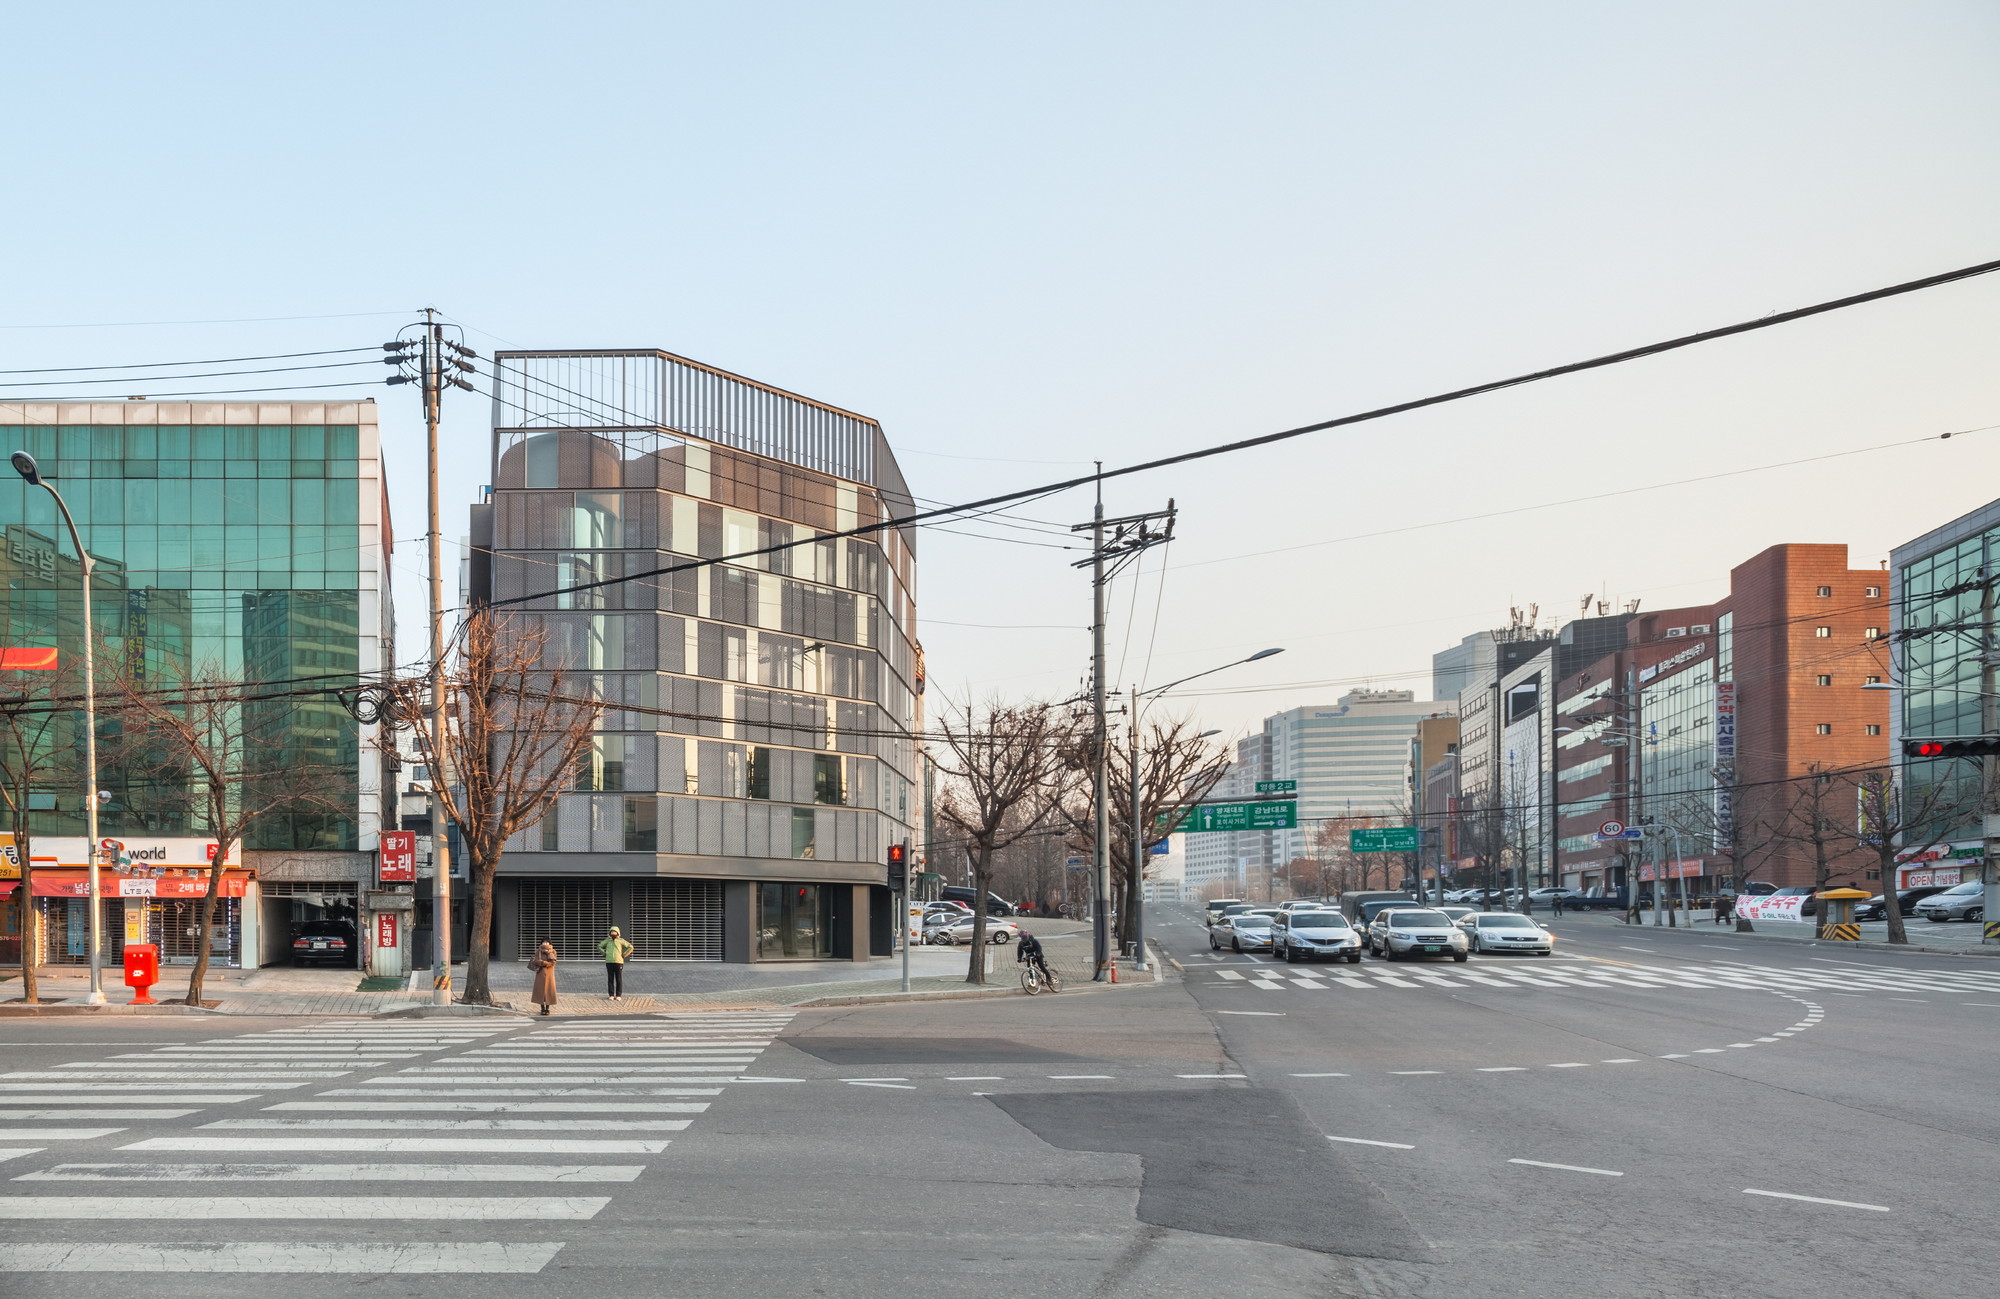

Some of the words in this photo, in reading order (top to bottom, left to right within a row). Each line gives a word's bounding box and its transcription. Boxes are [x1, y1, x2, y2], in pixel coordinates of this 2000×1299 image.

[1717, 683, 1735, 714] 현수막
[1259, 782, 1292, 790] 영동2교
[1216, 806, 1245, 814] 양재대로
[1254, 806, 1288, 814] 강남대로
[1604, 824, 1620, 833] 60
[387, 837, 408, 850] 딸기
[128, 847, 166, 859] world
[382, 853, 412, 872] 노래
[1910, 876, 1934, 887] OPEN
[178, 883, 194, 893] 2배
[382, 922, 392, 946] 노래방
